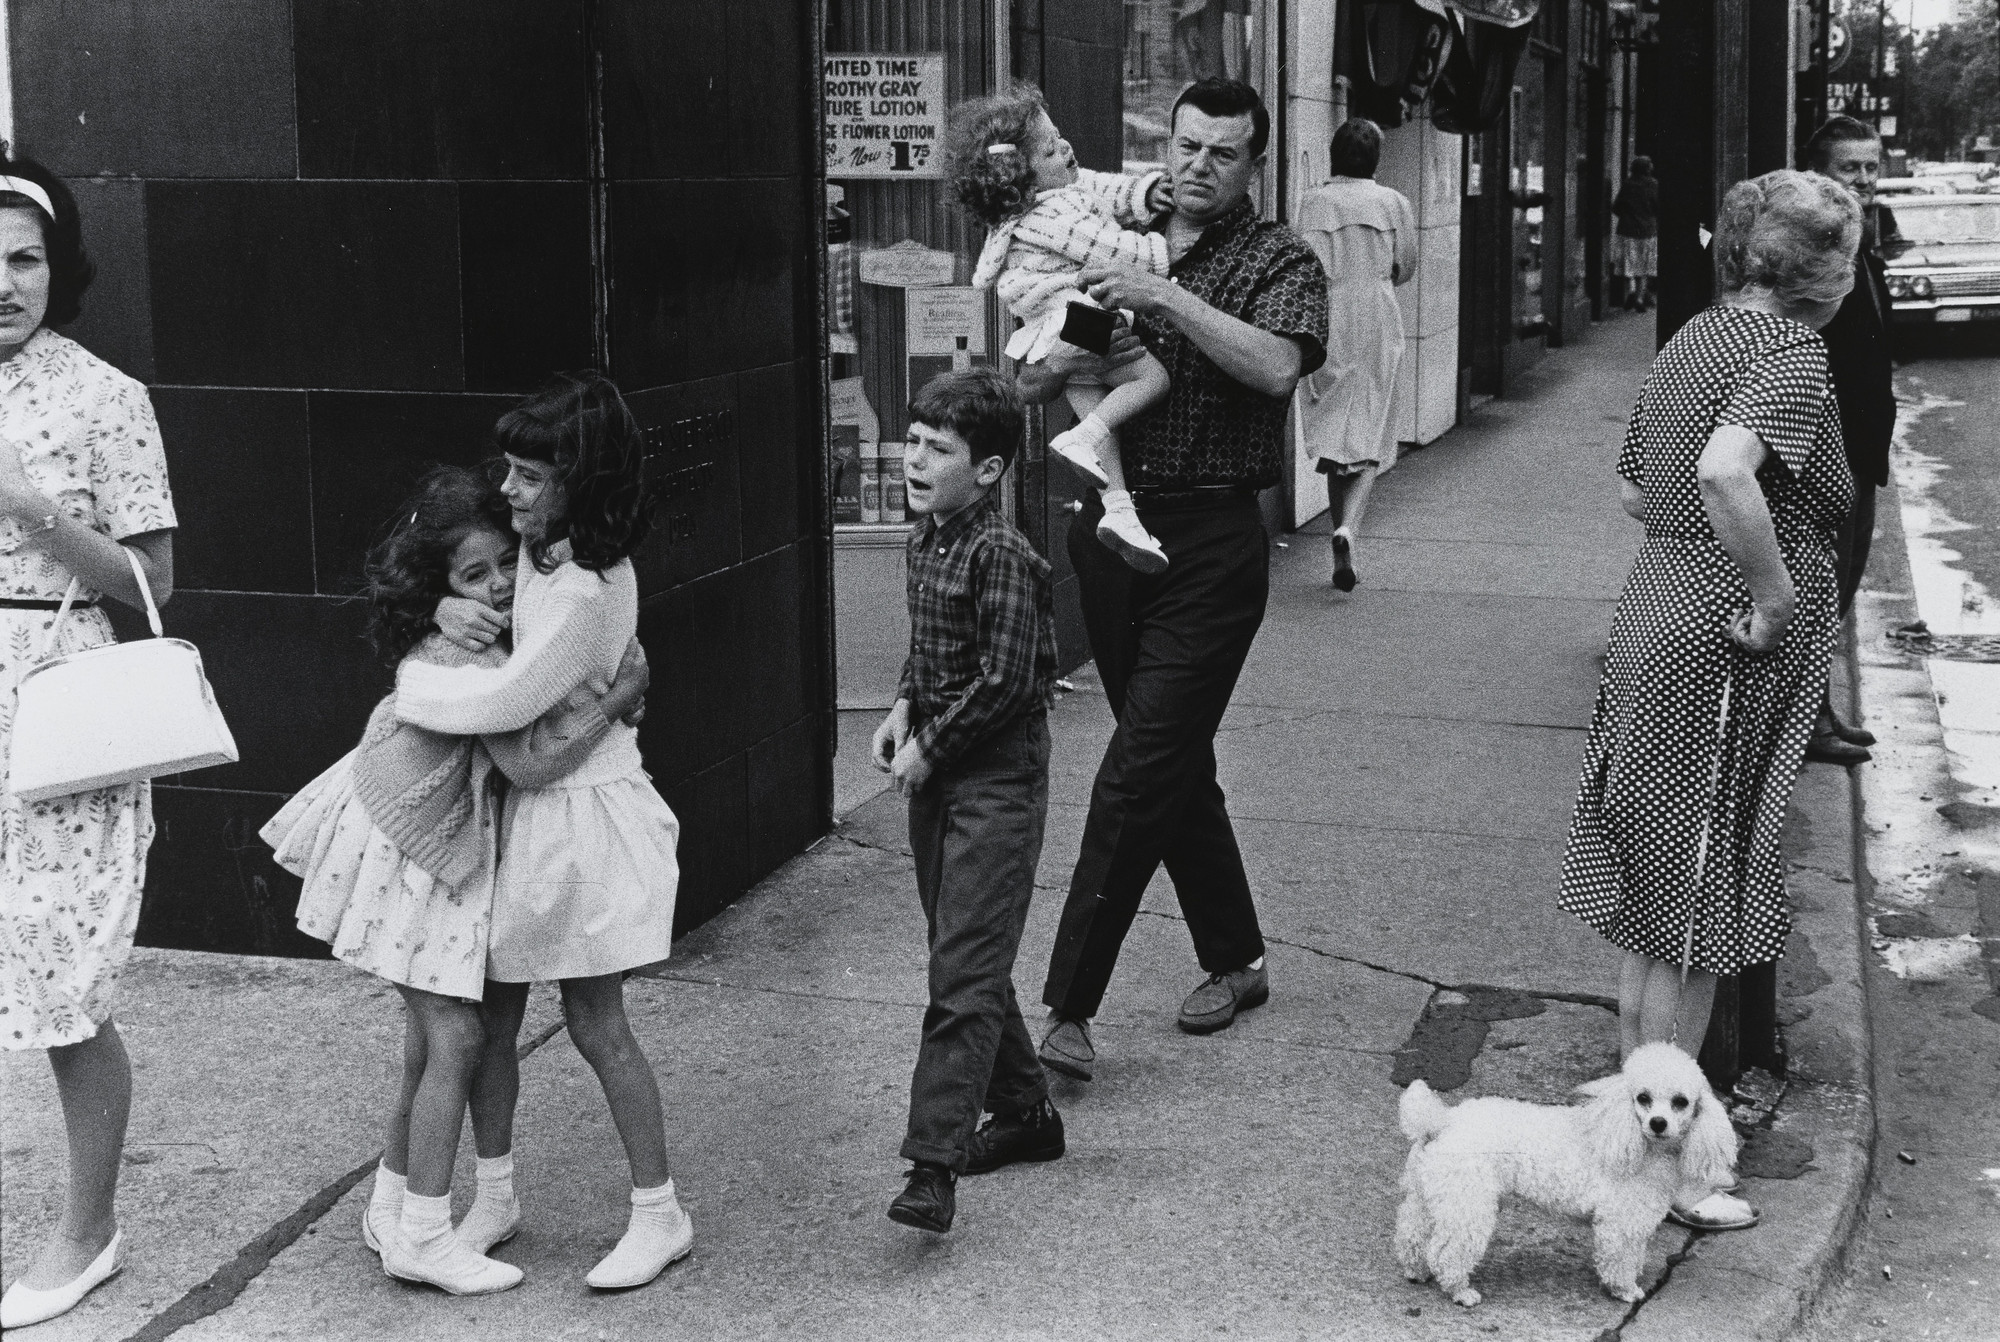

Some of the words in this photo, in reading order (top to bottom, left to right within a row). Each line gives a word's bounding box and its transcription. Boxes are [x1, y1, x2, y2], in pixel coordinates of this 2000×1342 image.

[876, 60, 918, 77] TIME
[826, 81, 876, 96] ROTHY
[879, 81, 921, 97] GRAY
[871, 100, 927, 116] LOTION
[842, 124, 890, 140] FLOWER
[894, 125, 935, 140] LOTION
[850, 145, 882, 167] Now
